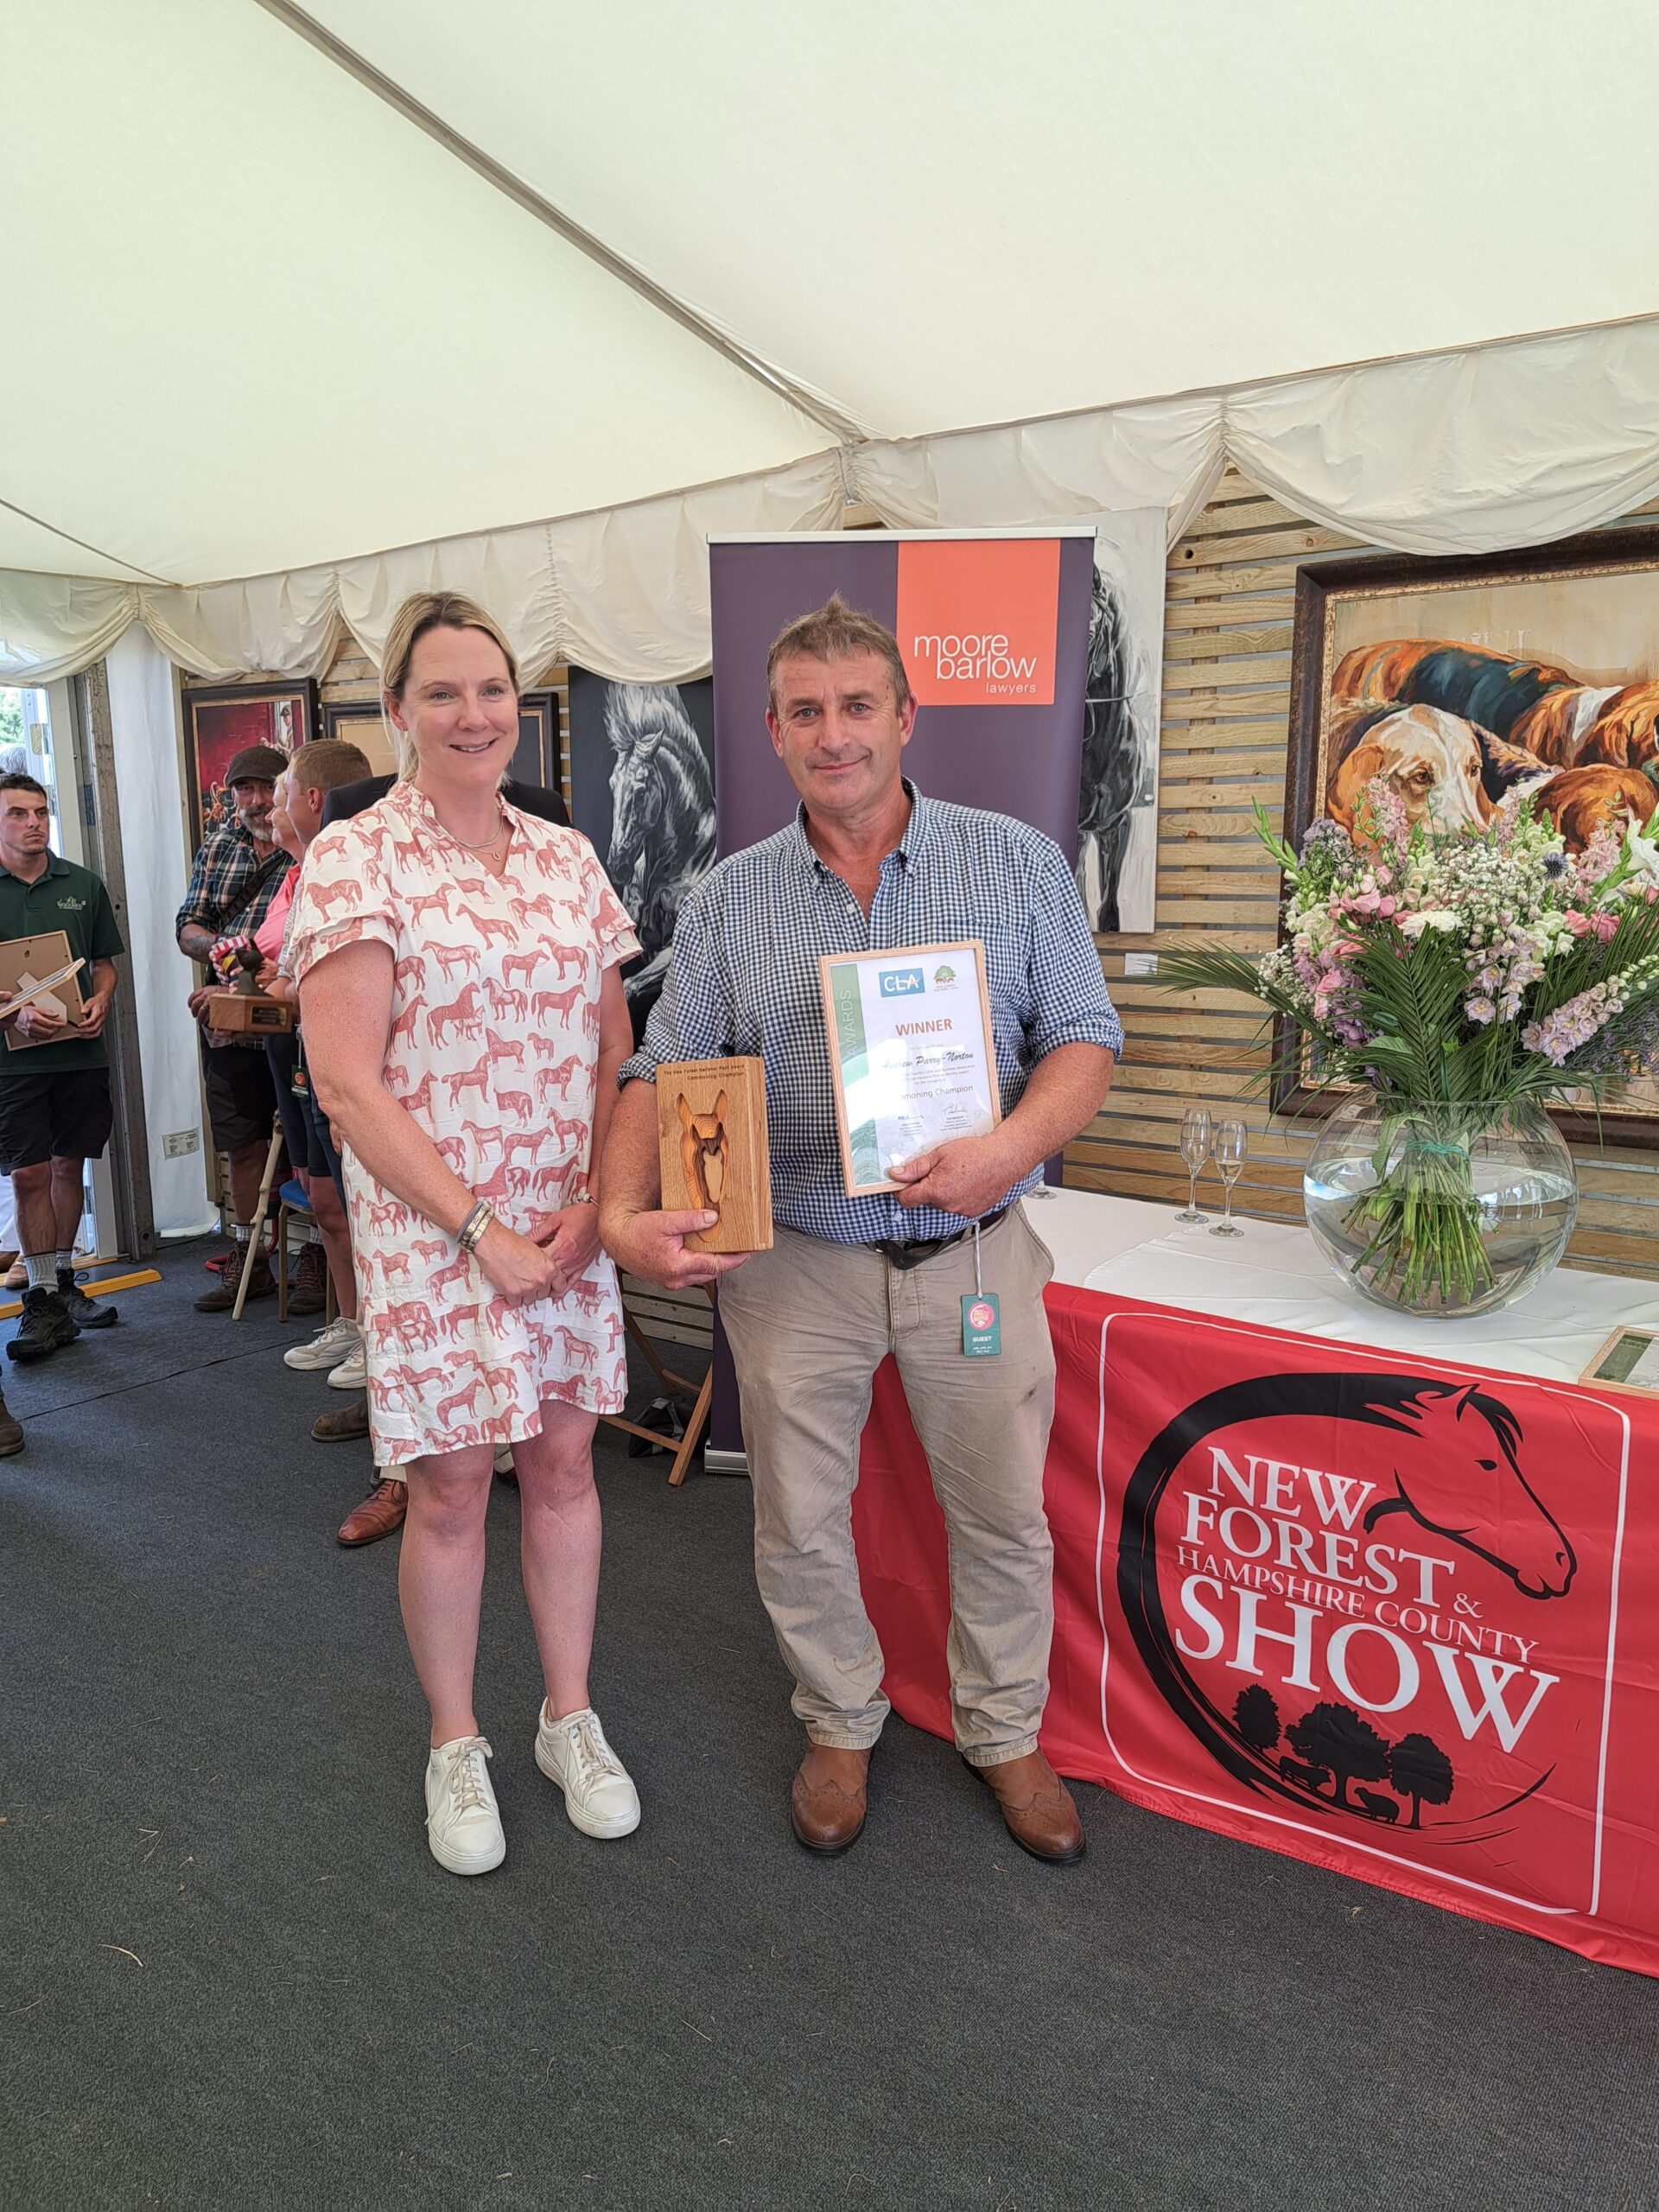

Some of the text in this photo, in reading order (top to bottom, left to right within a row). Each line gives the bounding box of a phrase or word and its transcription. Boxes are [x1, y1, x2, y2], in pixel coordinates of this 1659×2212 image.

[913, 635, 1008, 658] moore
[937, 650, 1037, 680] barlow
[986, 682, 1037, 696] lawyers
[884, 974, 919, 992] CLA
[839, 989, 858, 1058] AWARDS
[895, 1018, 953, 1037] WINNER
[915, 1051, 974, 1067] Parry-Norton
[935, 1084, 974, 1096] Champion
[1207, 1446, 1377, 1531] NEW
[1180, 1491, 1484, 1619] FOREST &
[1176, 1544, 1540, 1665] HAMPSHIRE COUNTY
[1175, 1573, 1560, 1754] SHOW
